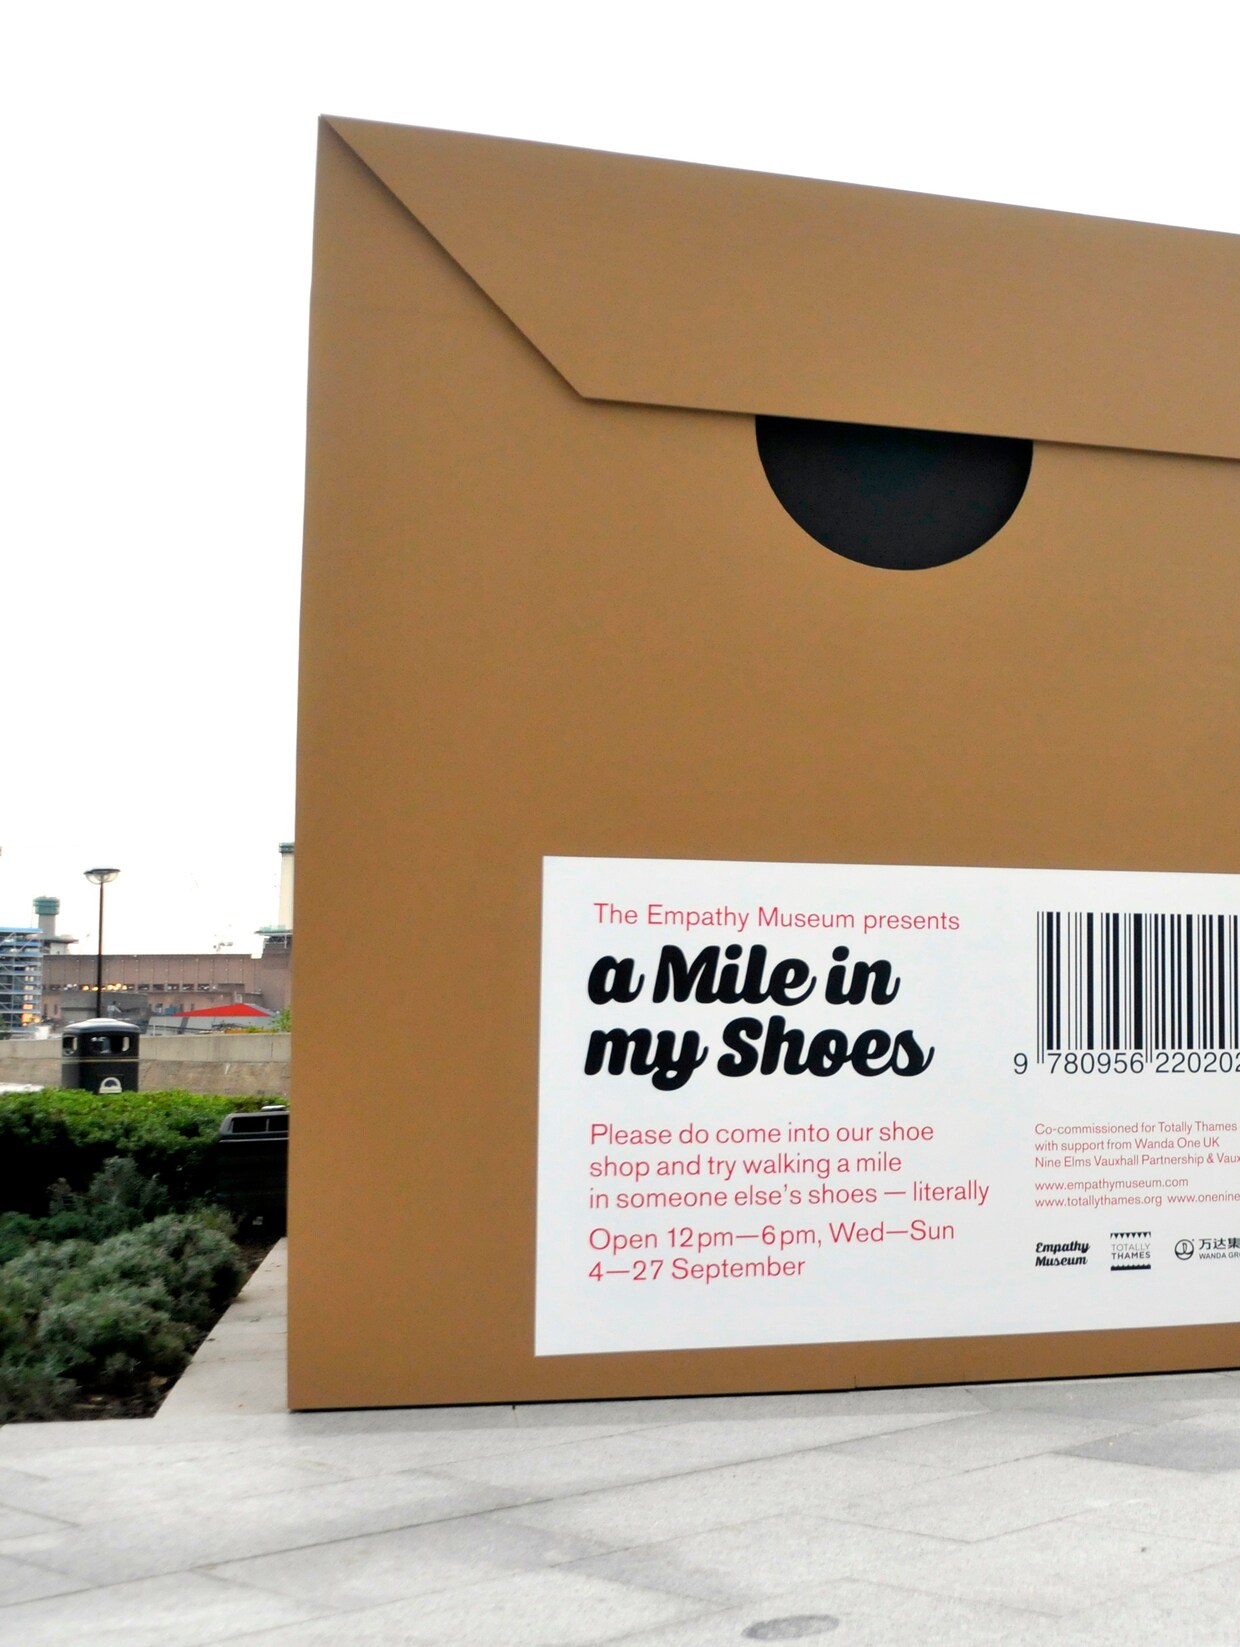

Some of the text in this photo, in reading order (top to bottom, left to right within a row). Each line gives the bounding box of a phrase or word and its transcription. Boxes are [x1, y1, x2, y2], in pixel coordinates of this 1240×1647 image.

[593, 902, 960, 935] The Empathy Museum presents
[587, 944, 901, 1007] a Mile in
[584, 1015, 935, 1091] my Shoes
[1013, 1052, 1029, 1076] 9
[1047, 1052, 1144, 1074] 780956
[590, 1120, 934, 1146] Please do come into our shoe
[1034, 1121, 1139, 1136] Co-commissioned
[1140, 1121, 1157, 1134] for
[1157, 1121, 1193, 1136] Totally
[1194, 1120, 1238, 1132] Thames
[1034, 1136, 1220, 1154] with support from Wanda One UK
[589, 1151, 902, 1183] shop and try walking a mile
[1034, 1156, 1062, 1168] Nine
[1063, 1155, 1092, 1168] Elms
[1093, 1154, 1139, 1167] Vauxhall
[1141, 1153, 1205, 1168] Partnership
[1206, 1152, 1215, 1165] &
[589, 1187, 609, 1209] in
[616, 1191, 728, 1209] someone
[808, 1182, 878, 1205] shoes
[913, 1179, 990, 1207] literally
[1034, 1177, 1189, 1193] www.empathymuseum.com
[1034, 1194, 1163, 1209] www.totallythames.org
[588, 1227, 658, 1256] Open
[1034, 1239, 1092, 1256] Empathy
[1112, 1243, 1150, 1252] TOTALLY
[1034, 1255, 1089, 1268] Museum
[1111, 1251, 1151, 1260] THAMES
[1198, 1251, 1227, 1260] WANDA
[671, 1255, 806, 1285] September
